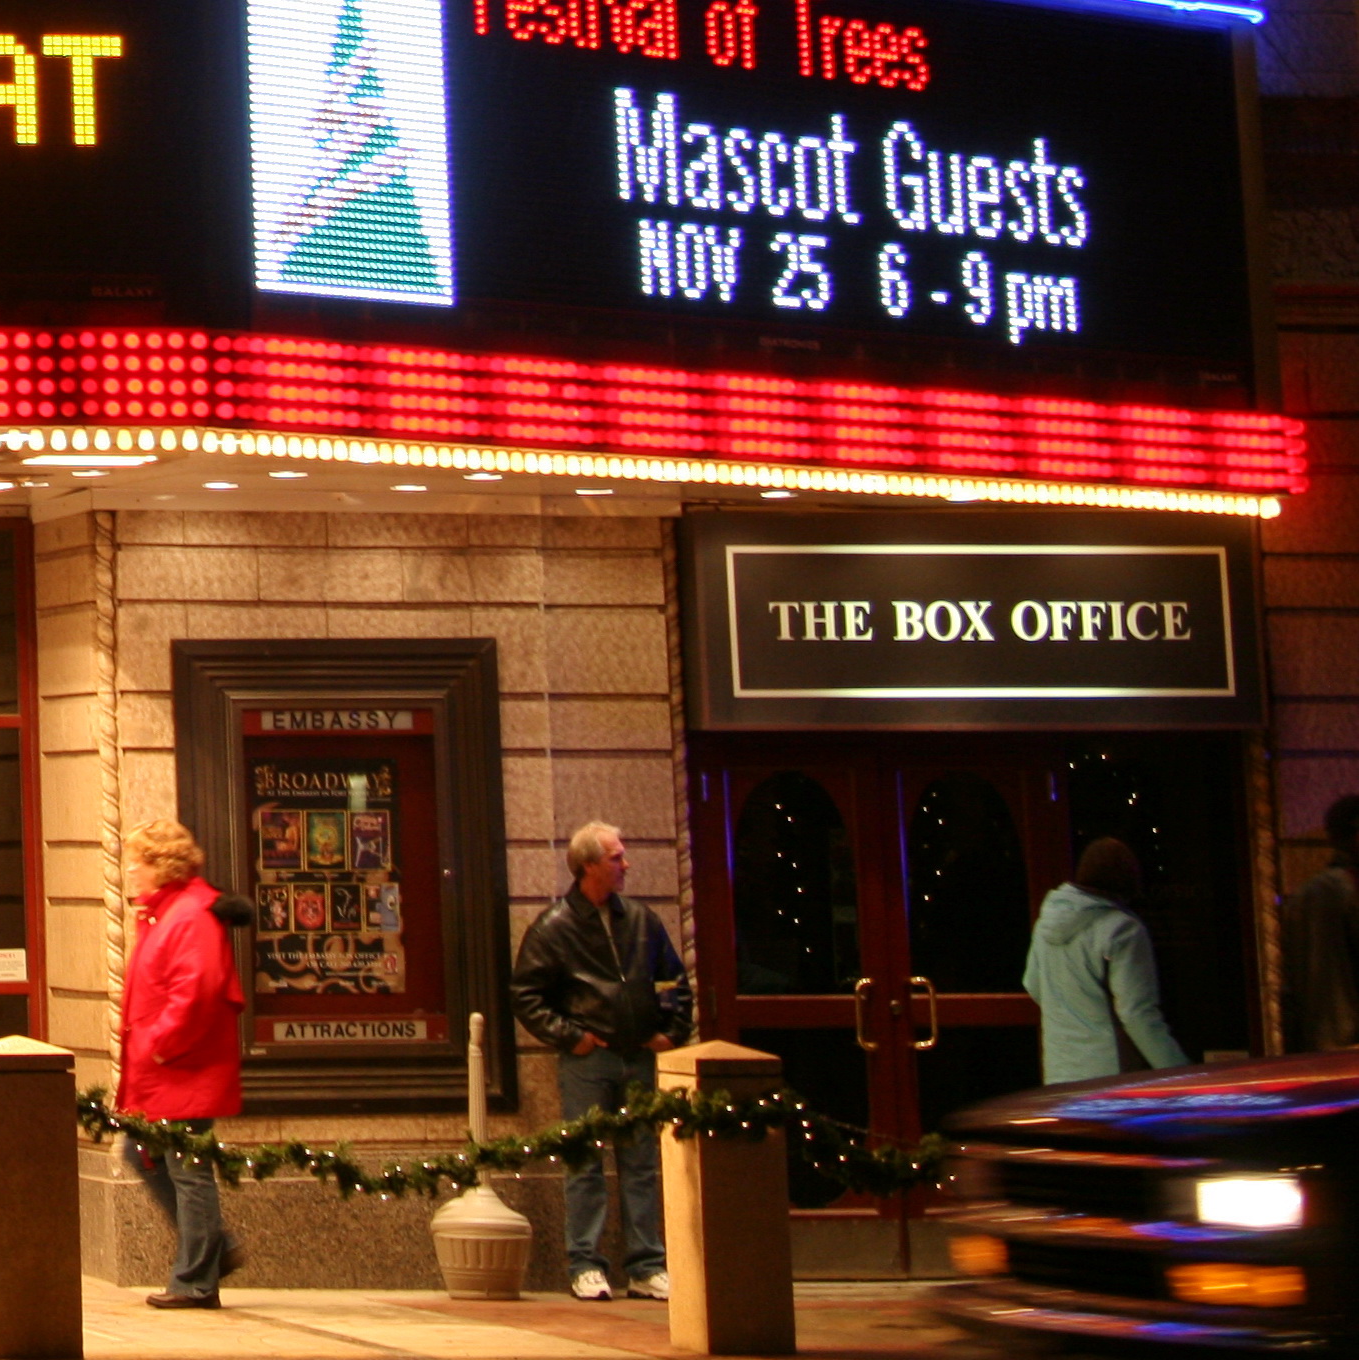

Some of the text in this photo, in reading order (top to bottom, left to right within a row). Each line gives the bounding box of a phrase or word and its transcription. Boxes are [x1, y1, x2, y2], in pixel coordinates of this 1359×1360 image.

[614, 87, 1090, 248] Mascot Guests
[638, 218, 744, 303] NOV
[770, 232, 834, 311] 25
[879, 242, 912, 318] 6
[768, 601, 1191, 642] THE BOX OFFICE
[272, 710, 400, 730] EMBASSY
[284, 1021, 417, 1039] ATTRACTIONS
